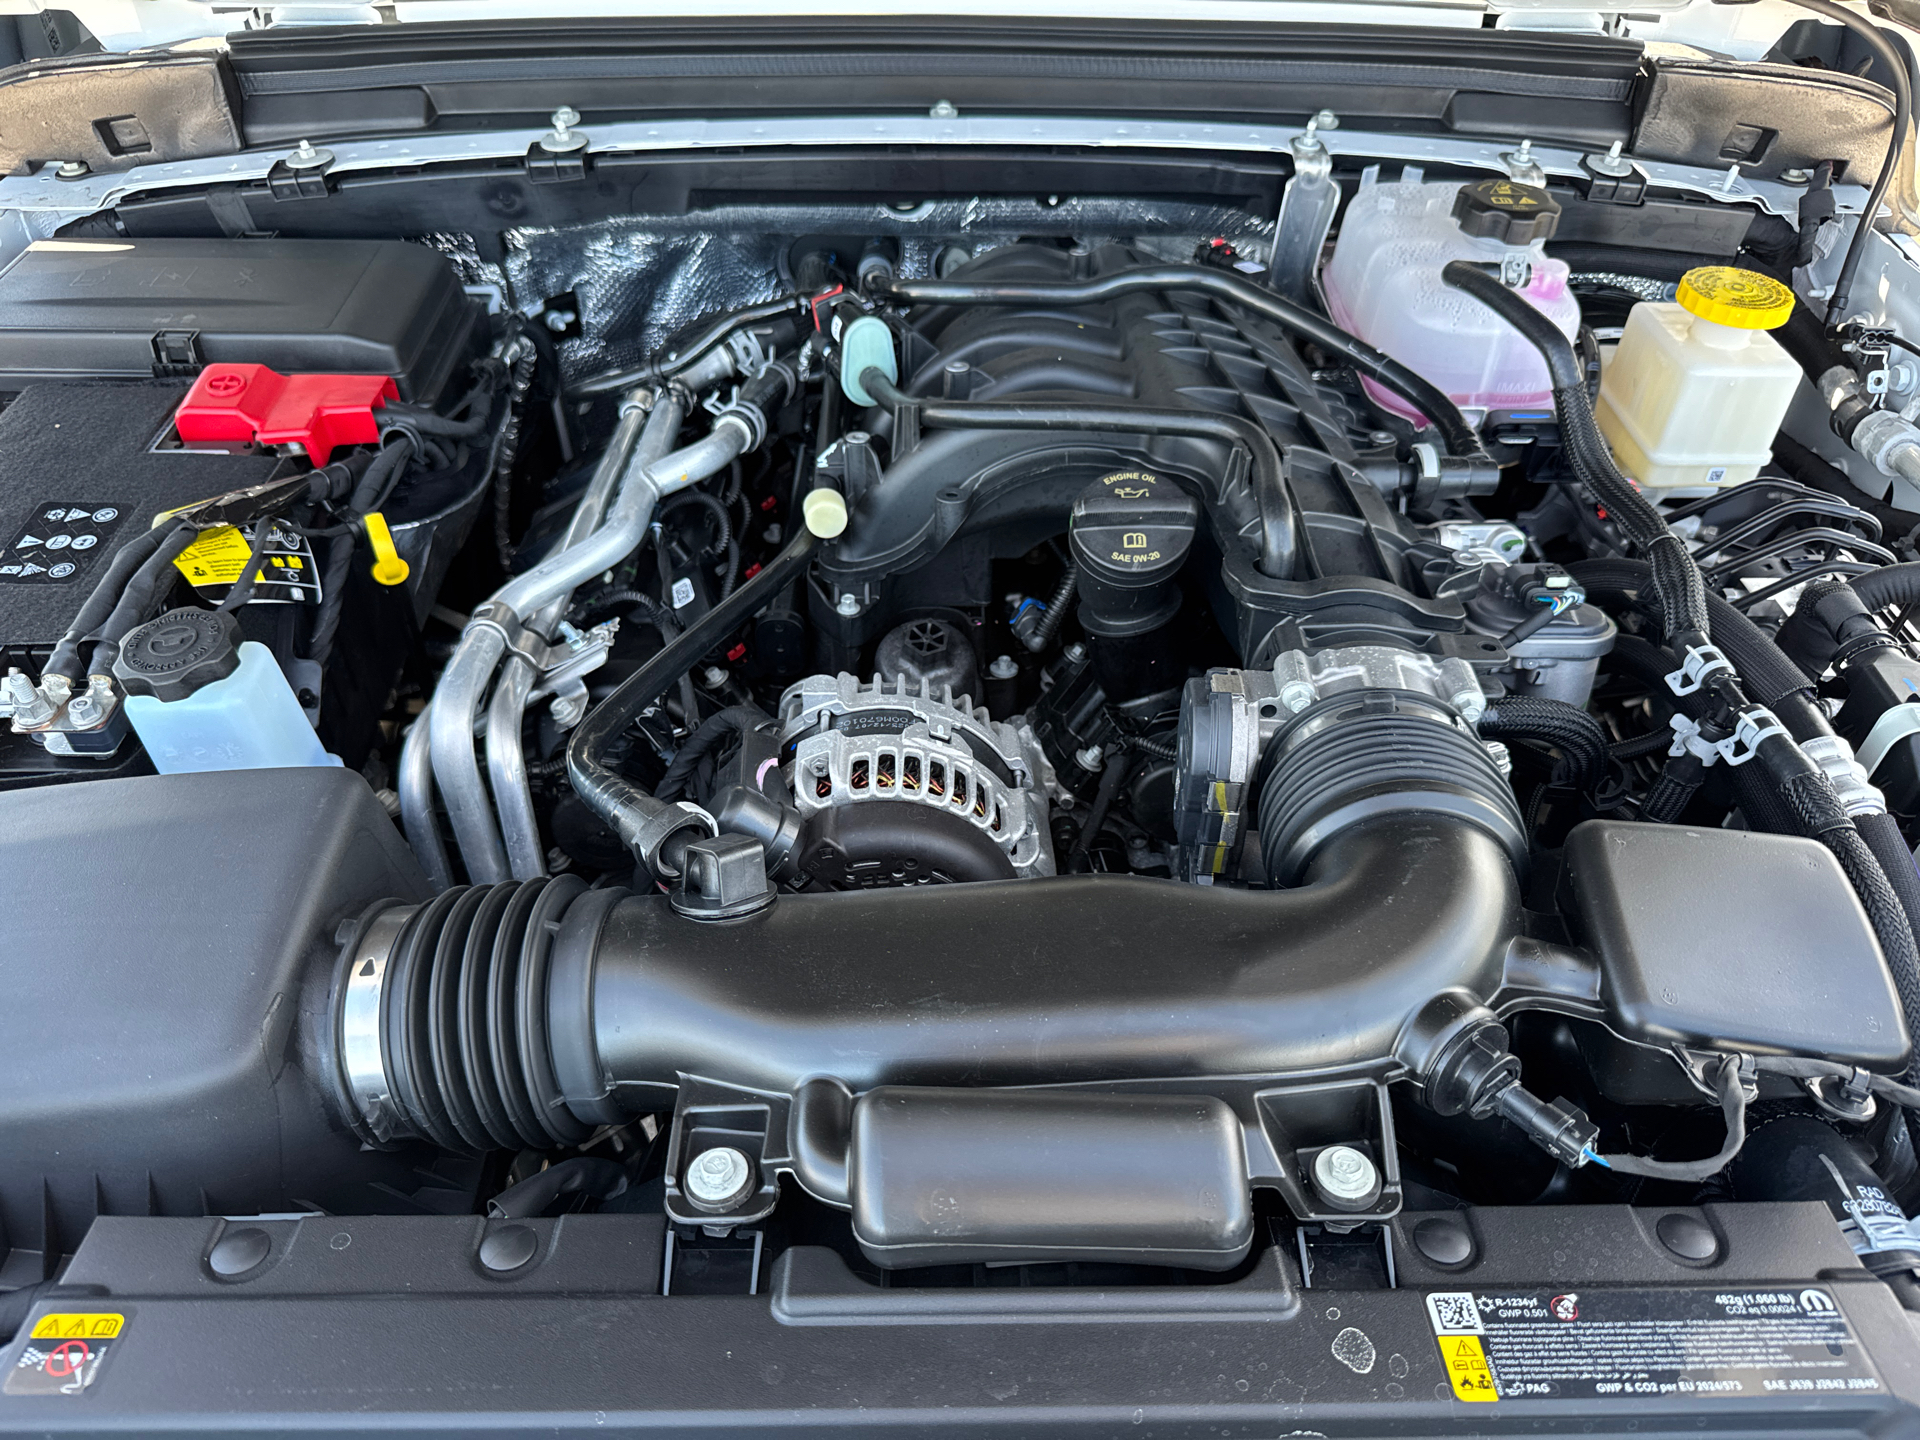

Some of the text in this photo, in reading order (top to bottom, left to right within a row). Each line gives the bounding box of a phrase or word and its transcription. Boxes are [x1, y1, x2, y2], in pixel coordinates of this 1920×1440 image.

[1103, 472, 1157, 486] ENGINE OIL
[1111, 551, 1160, 563] SAE 0W-20
[1856, 1185, 1885, 1200] RAD
[1495, 1298, 1538, 1308] R-1234yf
[1715, 1294, 1743, 1306] 482g
[1498, 1309, 1522, 1318] GWP
[1523, 1309, 1549, 1318] 0.501
[1526, 1383, 1551, 1394] PAG
[1595, 1382, 1623, 1393] GWP
[1624, 1382, 1634, 1393] &
[1634, 1382, 1659, 1393] CO2
[1659, 1383, 1677, 1394] per
[1678, 1382, 1695, 1392] EU
[1763, 1379, 1788, 1391] SAE
